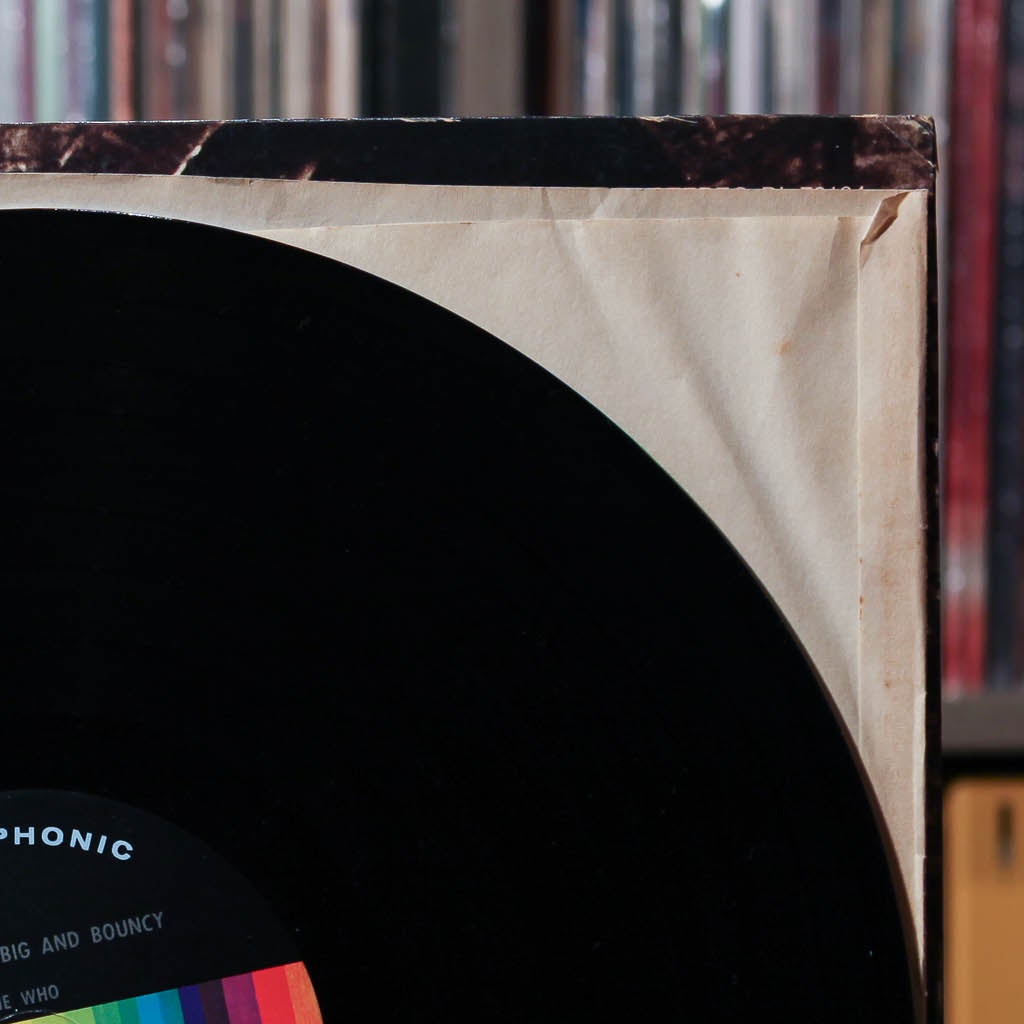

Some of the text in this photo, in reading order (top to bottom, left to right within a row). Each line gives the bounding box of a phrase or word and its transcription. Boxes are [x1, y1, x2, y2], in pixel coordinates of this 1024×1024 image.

[0, 940, 31, 964] BIG
[41, 931, 80, 955] AND
[90, 911, 166, 945] BOUNCY
[20, 983, 61, 1007] WHO
